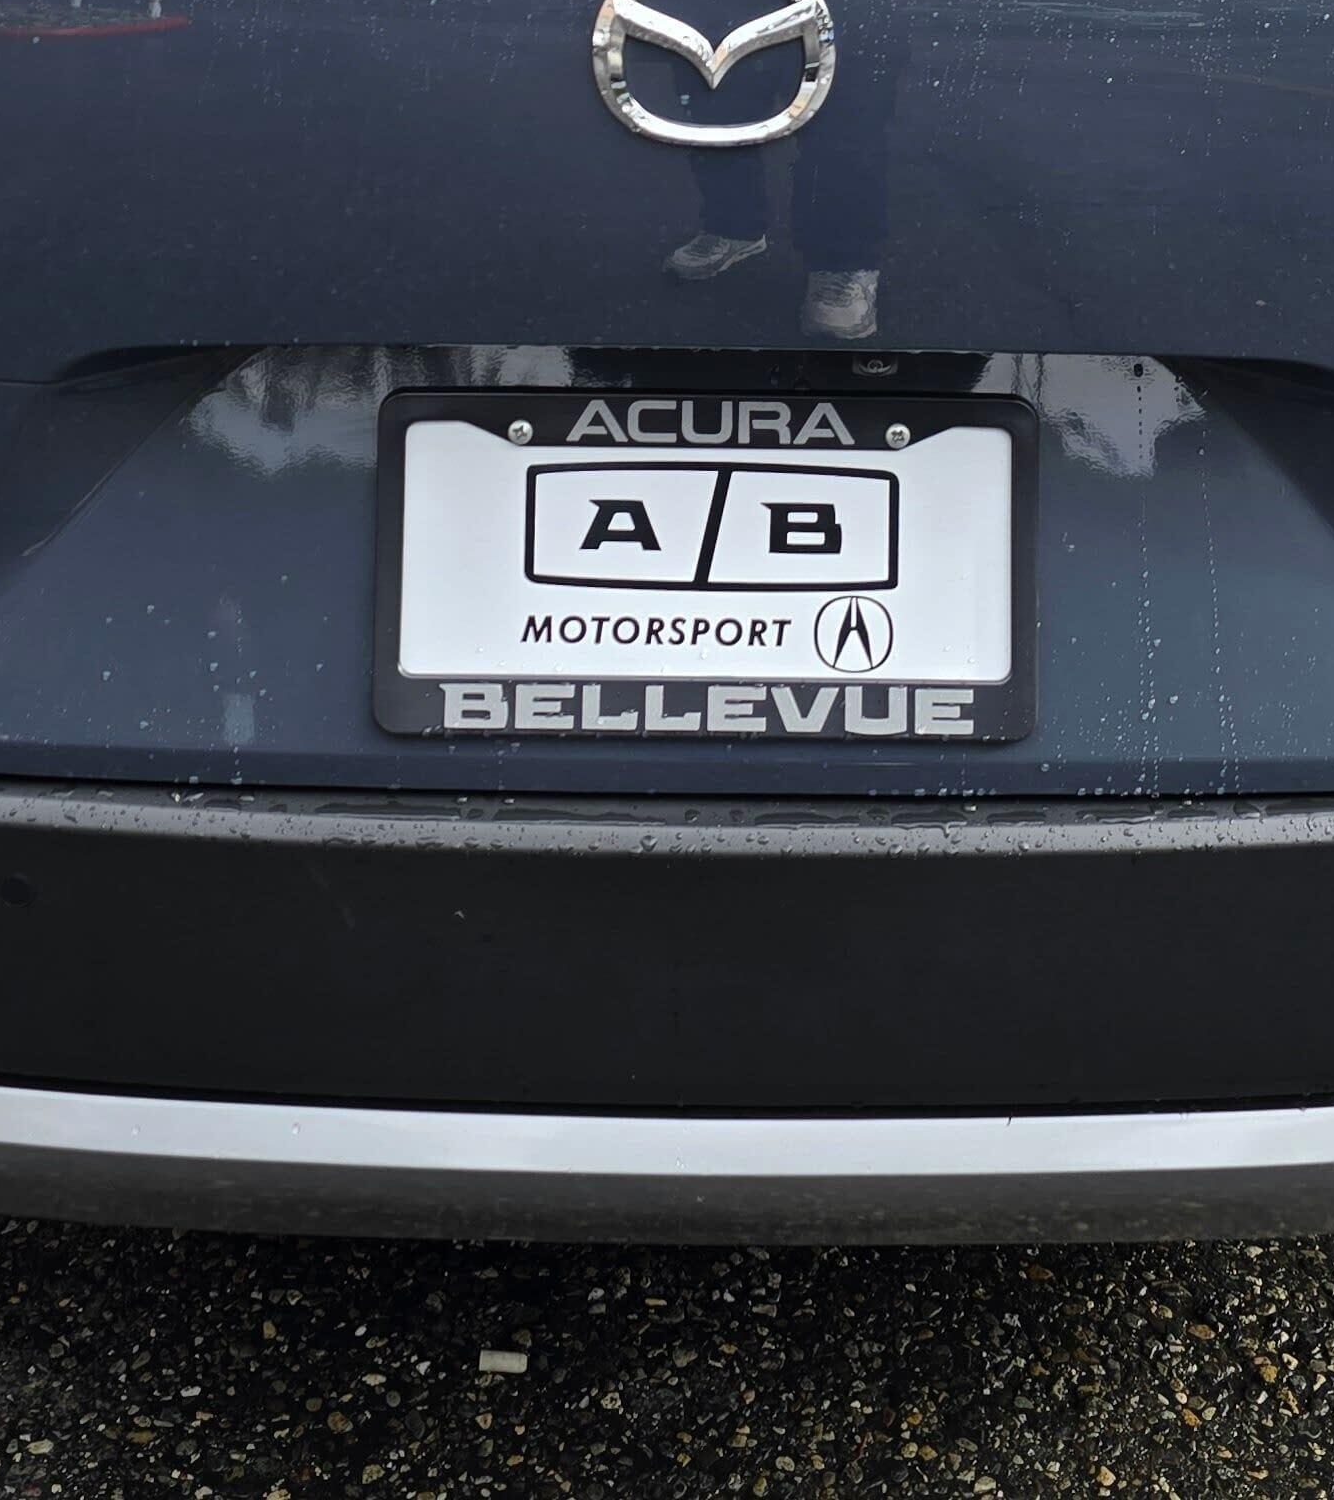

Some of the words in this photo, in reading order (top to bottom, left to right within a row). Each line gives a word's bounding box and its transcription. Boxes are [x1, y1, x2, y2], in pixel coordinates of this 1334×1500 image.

[565, 399, 856, 446] ACURA
[579, 498, 662, 552] A
[760, 501, 843, 554] B
[519, 614, 792, 648] MOTORSPORT
[438, 681, 975, 736] BELLEVUE
